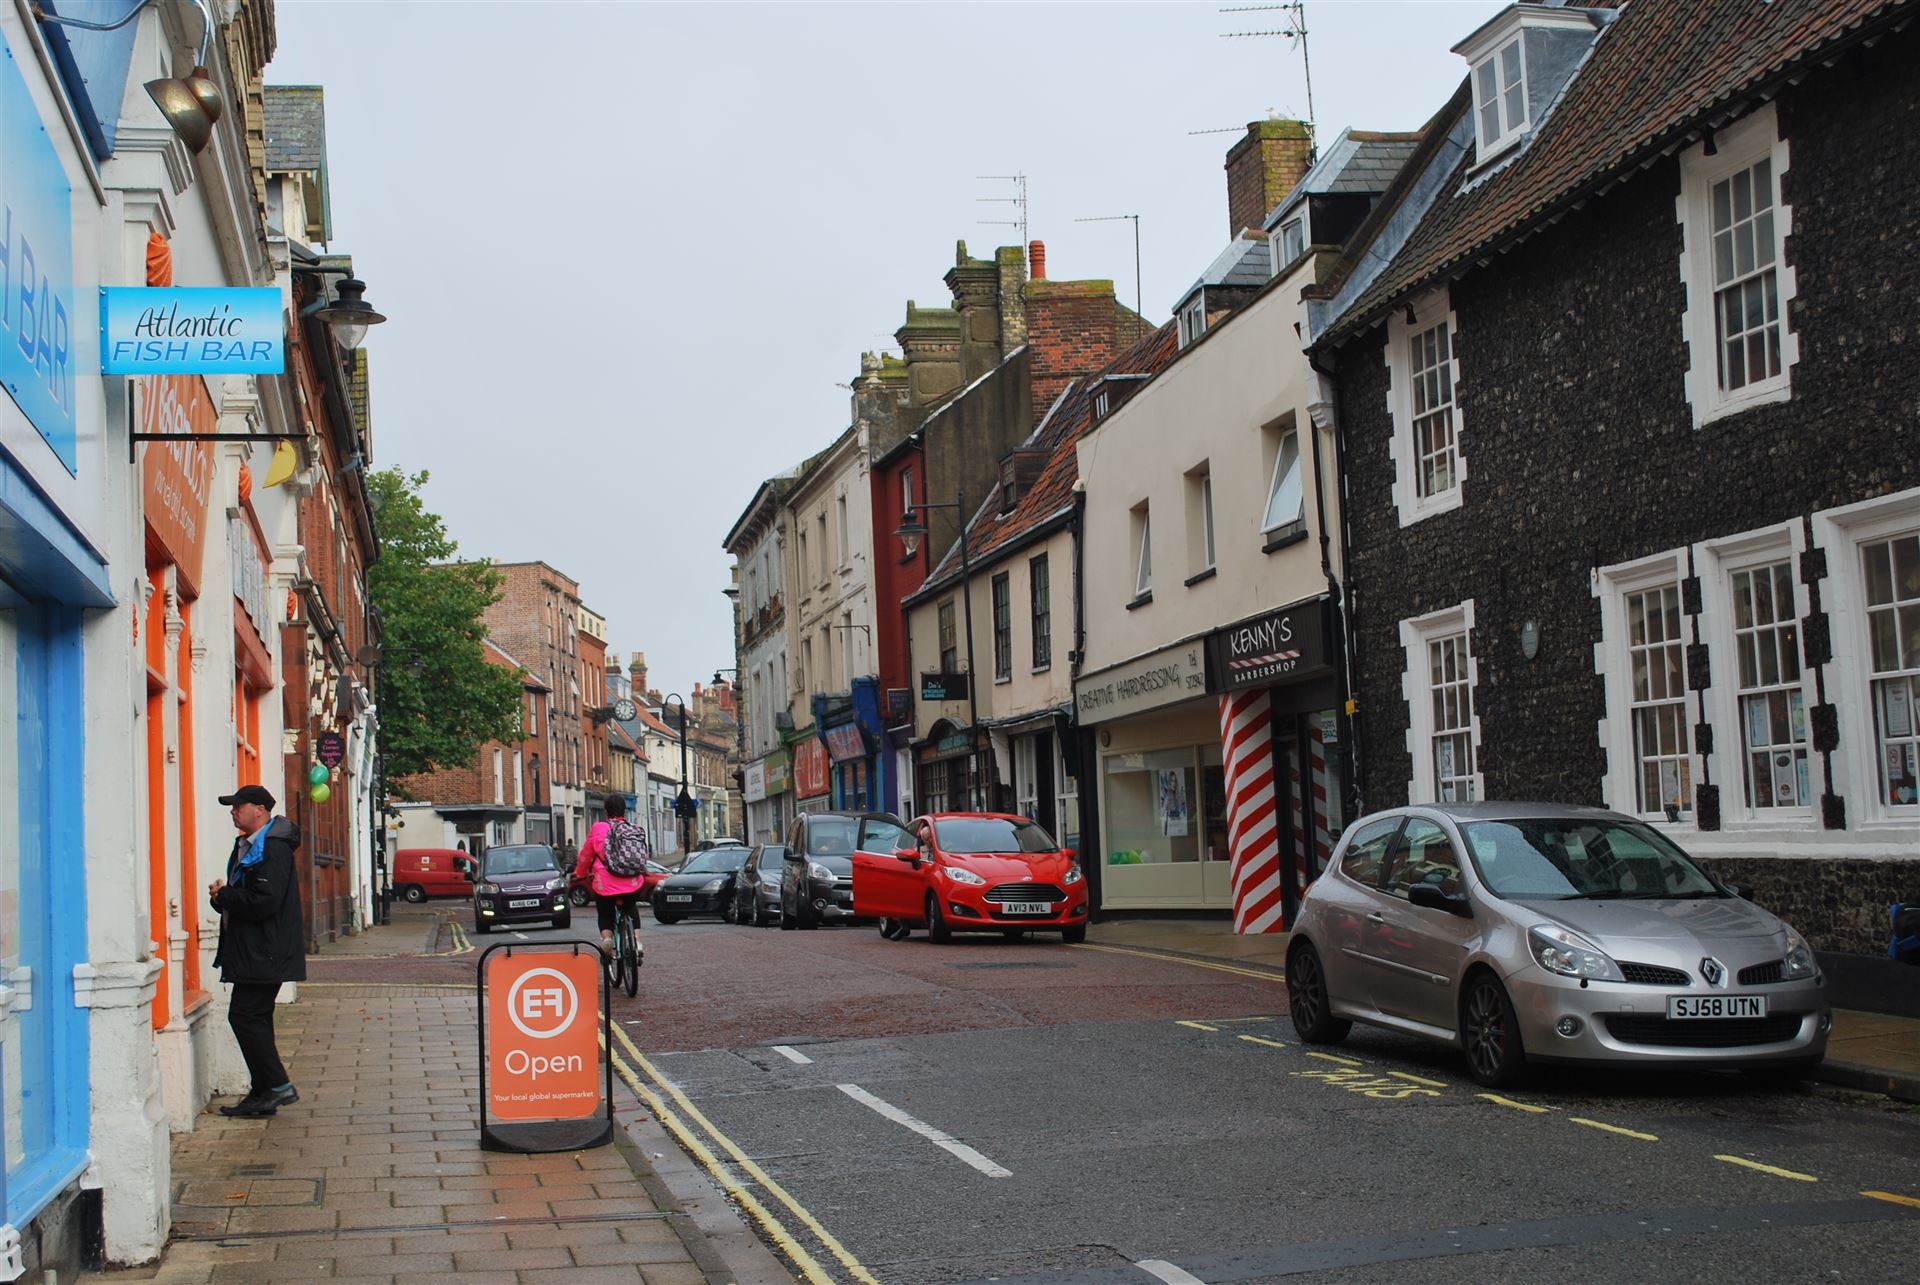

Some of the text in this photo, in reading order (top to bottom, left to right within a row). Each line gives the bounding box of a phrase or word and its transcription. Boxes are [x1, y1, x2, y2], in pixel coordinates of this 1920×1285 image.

[18, 233, 69, 418] BAR
[135, 300, 243, 338] Atlantic
[113, 341, 273, 362] FISH BAR
[1230, 616, 1292, 656] KENNY'S
[1117, 663, 1181, 699] HAIRDRESSING
[1234, 660, 1296, 683] BARBERSHOP
[1007, 903, 1046, 912] AV13 NVL
[1677, 998, 1759, 1016] SJ58 UTN
[505, 1050, 583, 1080] Open
[494, 1090, 594, 1102] Your local global supermarket
